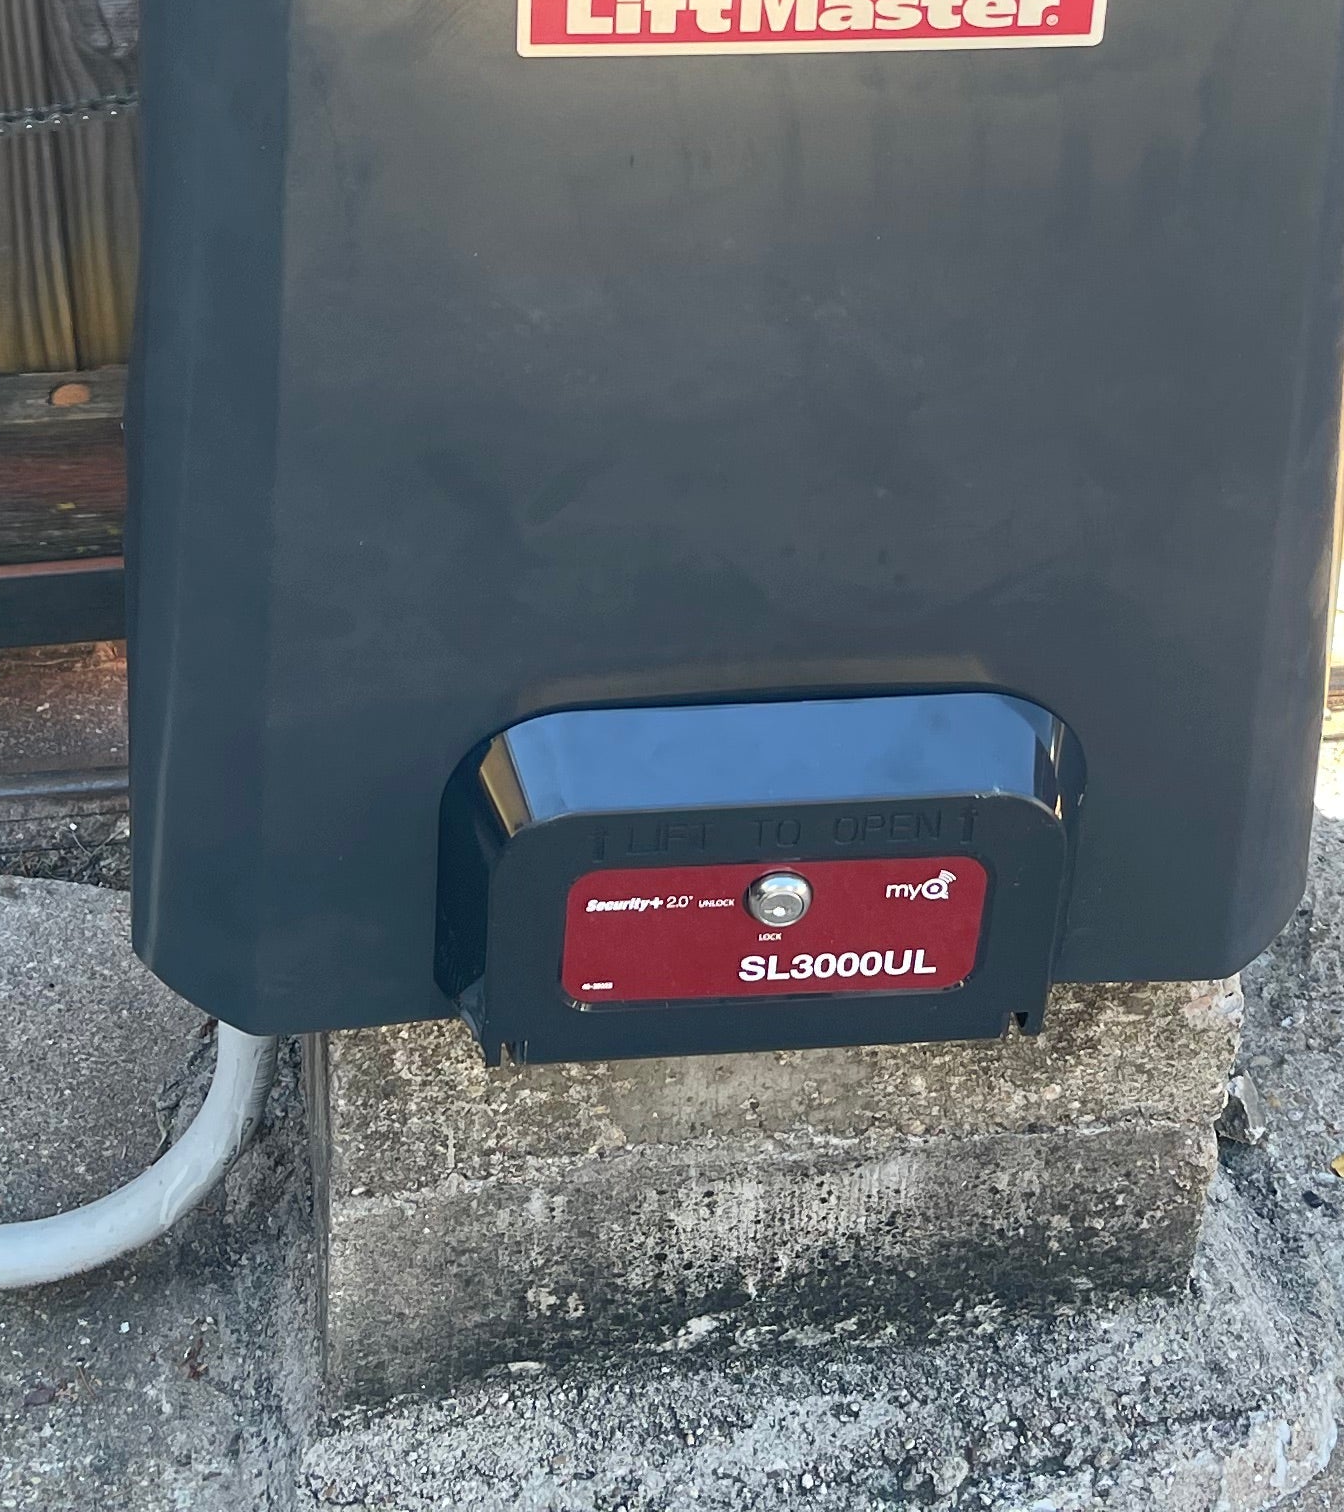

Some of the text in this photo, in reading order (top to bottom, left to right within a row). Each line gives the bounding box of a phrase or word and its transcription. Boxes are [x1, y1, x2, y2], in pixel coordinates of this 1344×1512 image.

[626, 809, 942, 856] LIFT TO OPEN
[885, 877, 949, 901] myQ
[585, 896, 664, 913] Security+
[698, 898, 735, 908] UNLOCK
[758, 932, 783, 942] LOCK
[738, 949, 937, 982] SL3000UL
